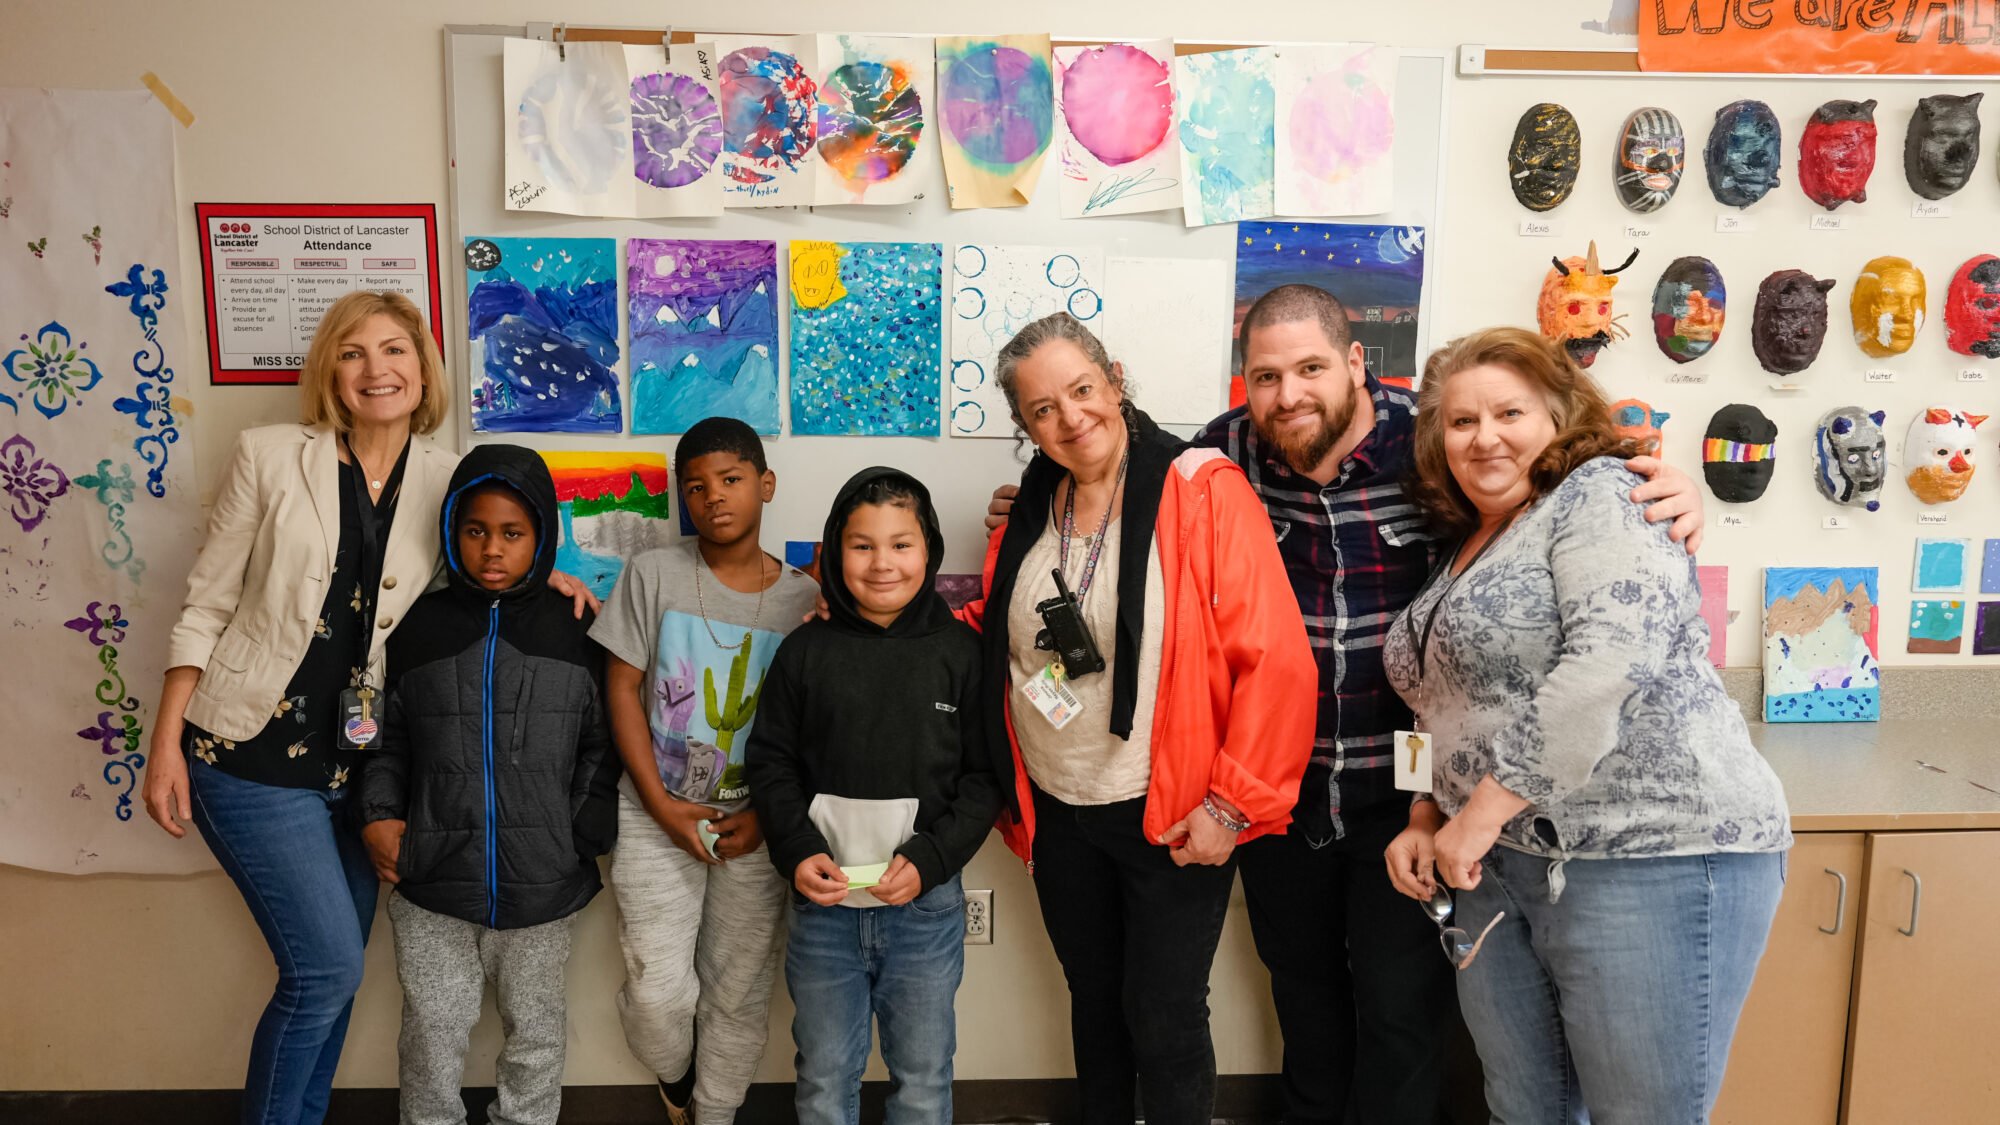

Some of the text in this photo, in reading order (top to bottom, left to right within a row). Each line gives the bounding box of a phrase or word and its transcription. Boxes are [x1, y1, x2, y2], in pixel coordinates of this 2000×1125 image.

[264, 225, 409, 235] School District of Lancaster
[1525, 223, 1550, 234] Alexis
[214, 239, 259, 248] Lancaster
[304, 241, 371, 250] Attendance
[317, 279, 335, 287] every
[337, 278, 348, 286] day
[274, 287, 286, 295] day
[234, 325, 264, 333] absences
[253, 357, 282, 366] MISS
[1963, 371, 1982, 379] Gabe
